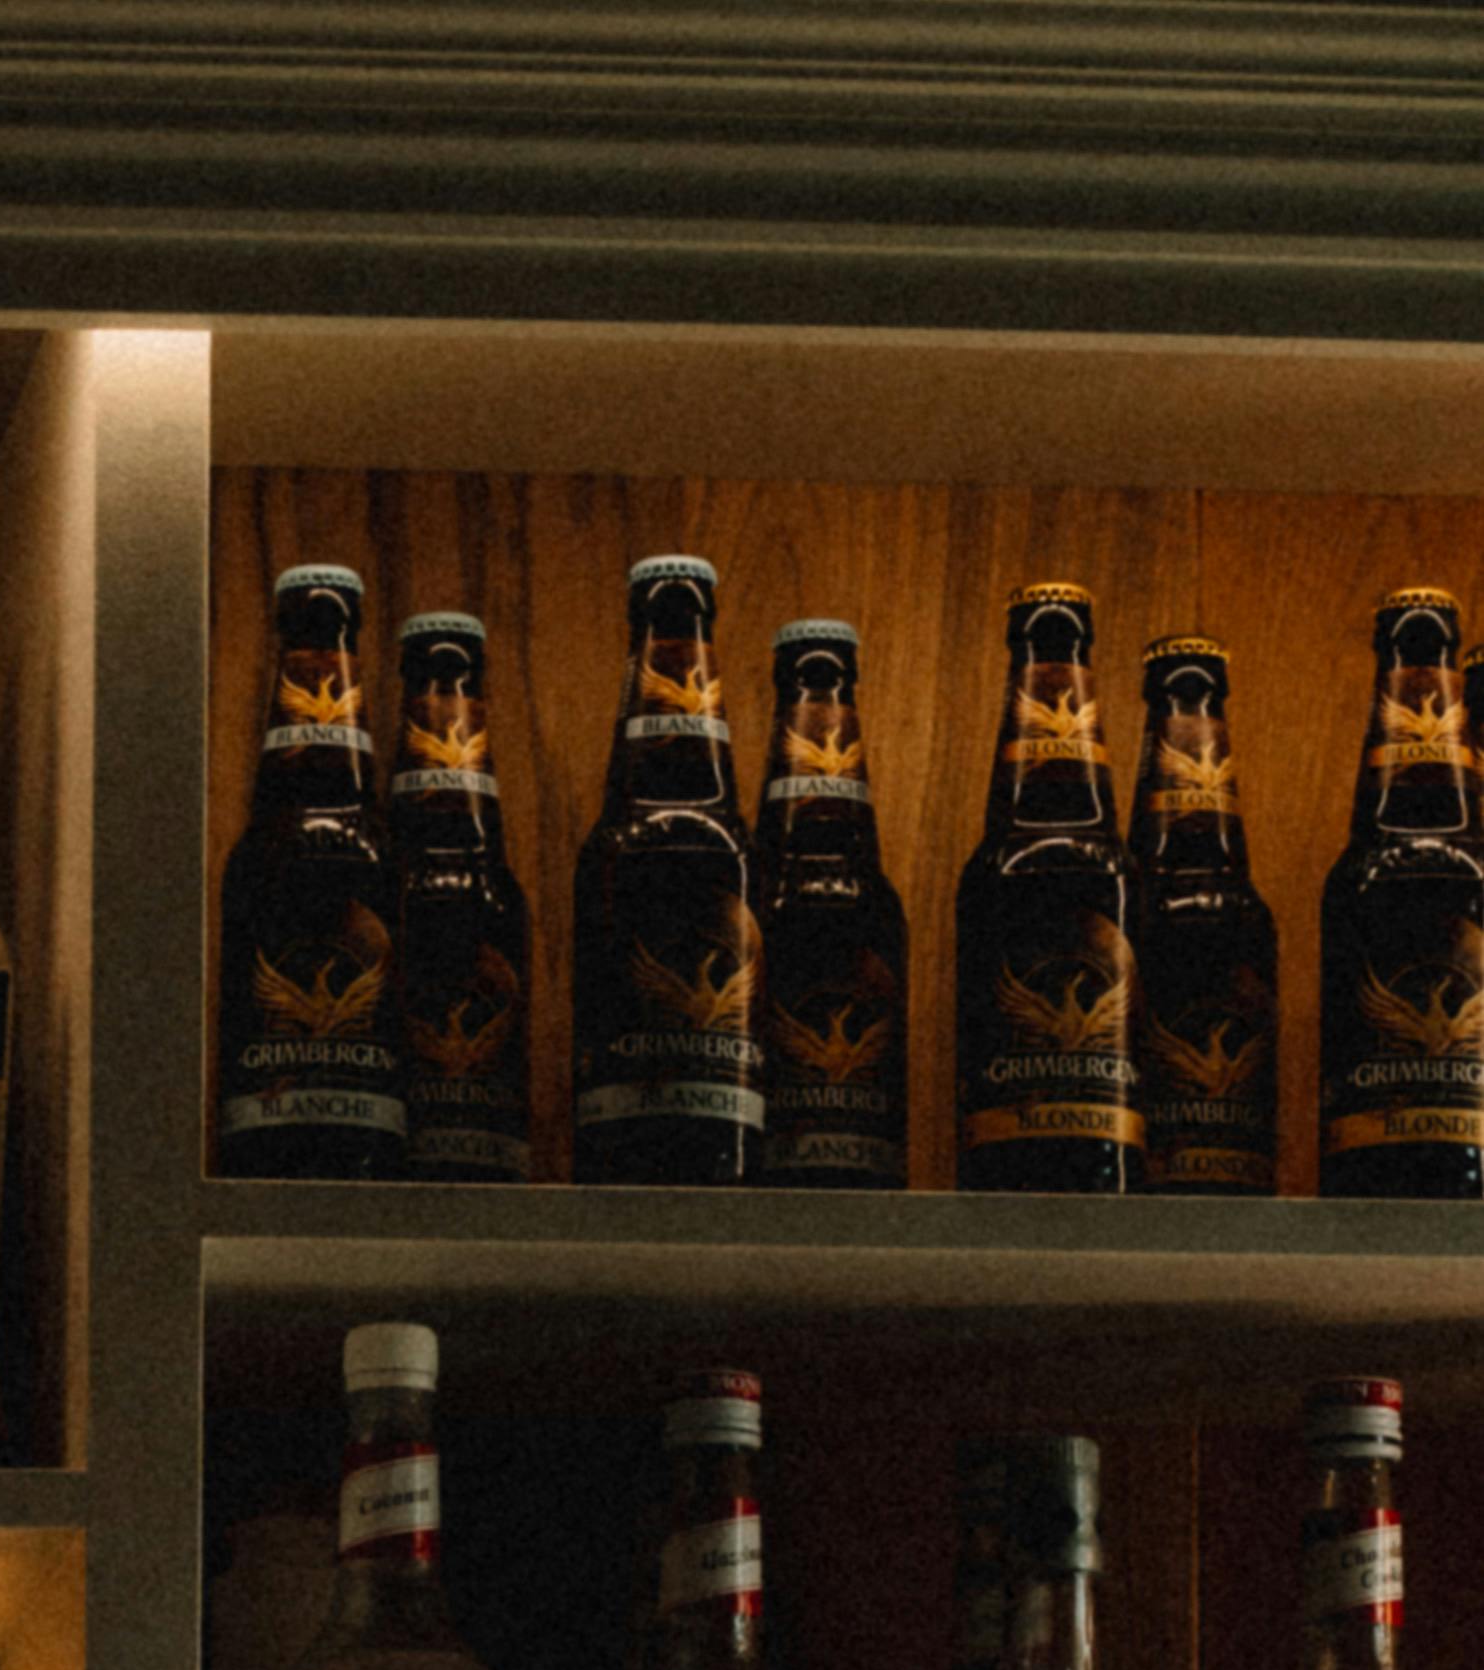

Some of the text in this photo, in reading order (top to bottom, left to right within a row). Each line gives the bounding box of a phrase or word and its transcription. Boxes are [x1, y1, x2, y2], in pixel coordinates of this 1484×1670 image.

[276, 727, 366, 746] BLANCE
[240, 1041, 398, 1072] GRIMBERGEN
[1352, 1060, 1484, 1088] GRIMBERG
[261, 1093, 374, 1118] BLANCHE
